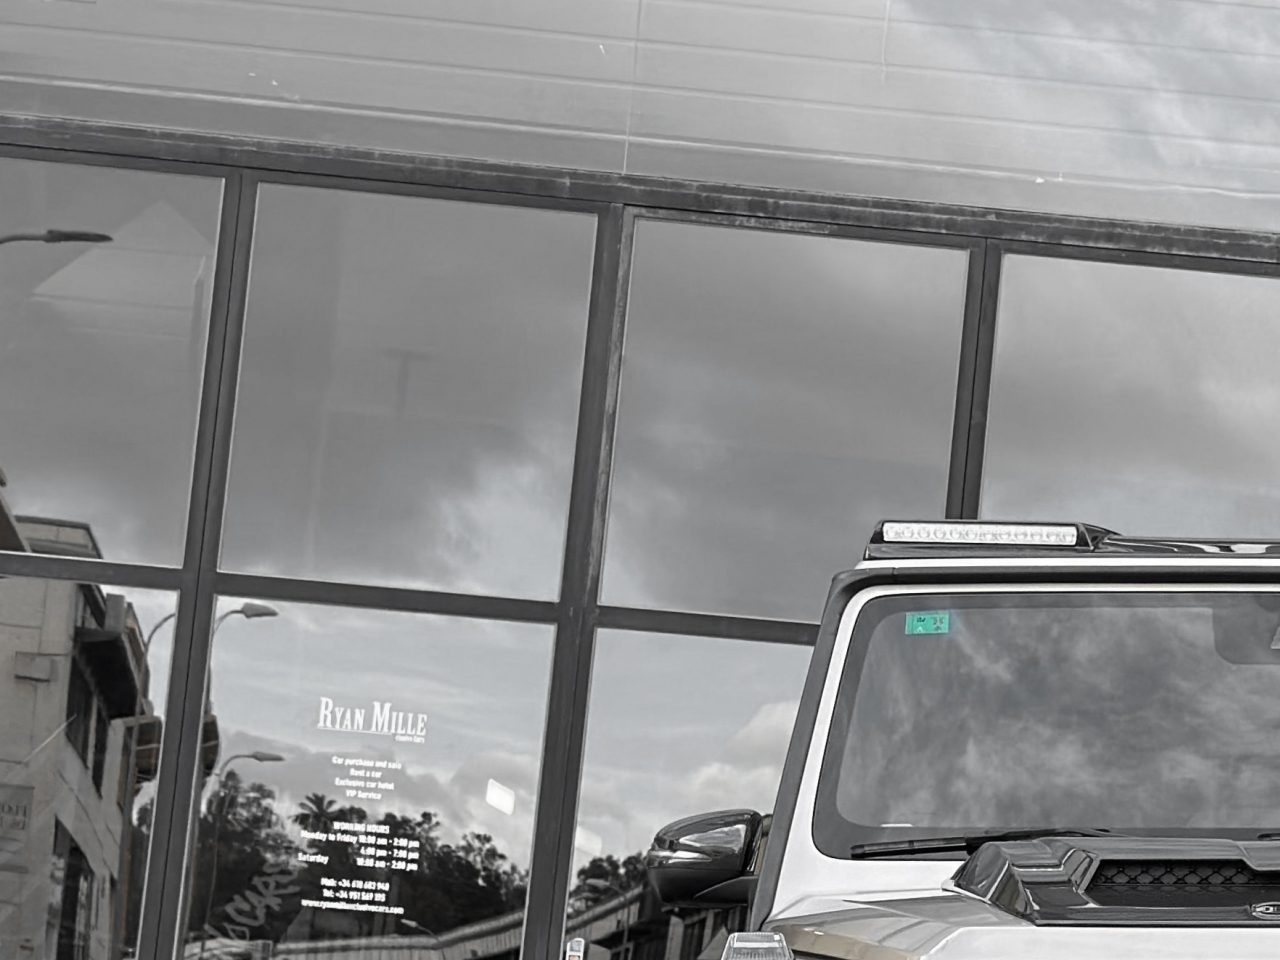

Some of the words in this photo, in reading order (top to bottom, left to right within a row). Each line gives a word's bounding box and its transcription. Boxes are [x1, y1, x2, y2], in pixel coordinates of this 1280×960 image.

[333, 821, 366, 832] WORKING
[366, 824, 390, 834] HOURS
[300, 830, 327, 842] Monday
[328, 833, 335, 841] to
[336, 833, 357, 844] Friday
[376, 838, 388, 846] am
[408, 840, 420, 849] pm
[297, 852, 329, 865] Saturday
[374, 860, 386, 868] am
[406, 863, 419, 871] pm
[376, 849, 387, 857] pm
[408, 852, 420, 860] pm
